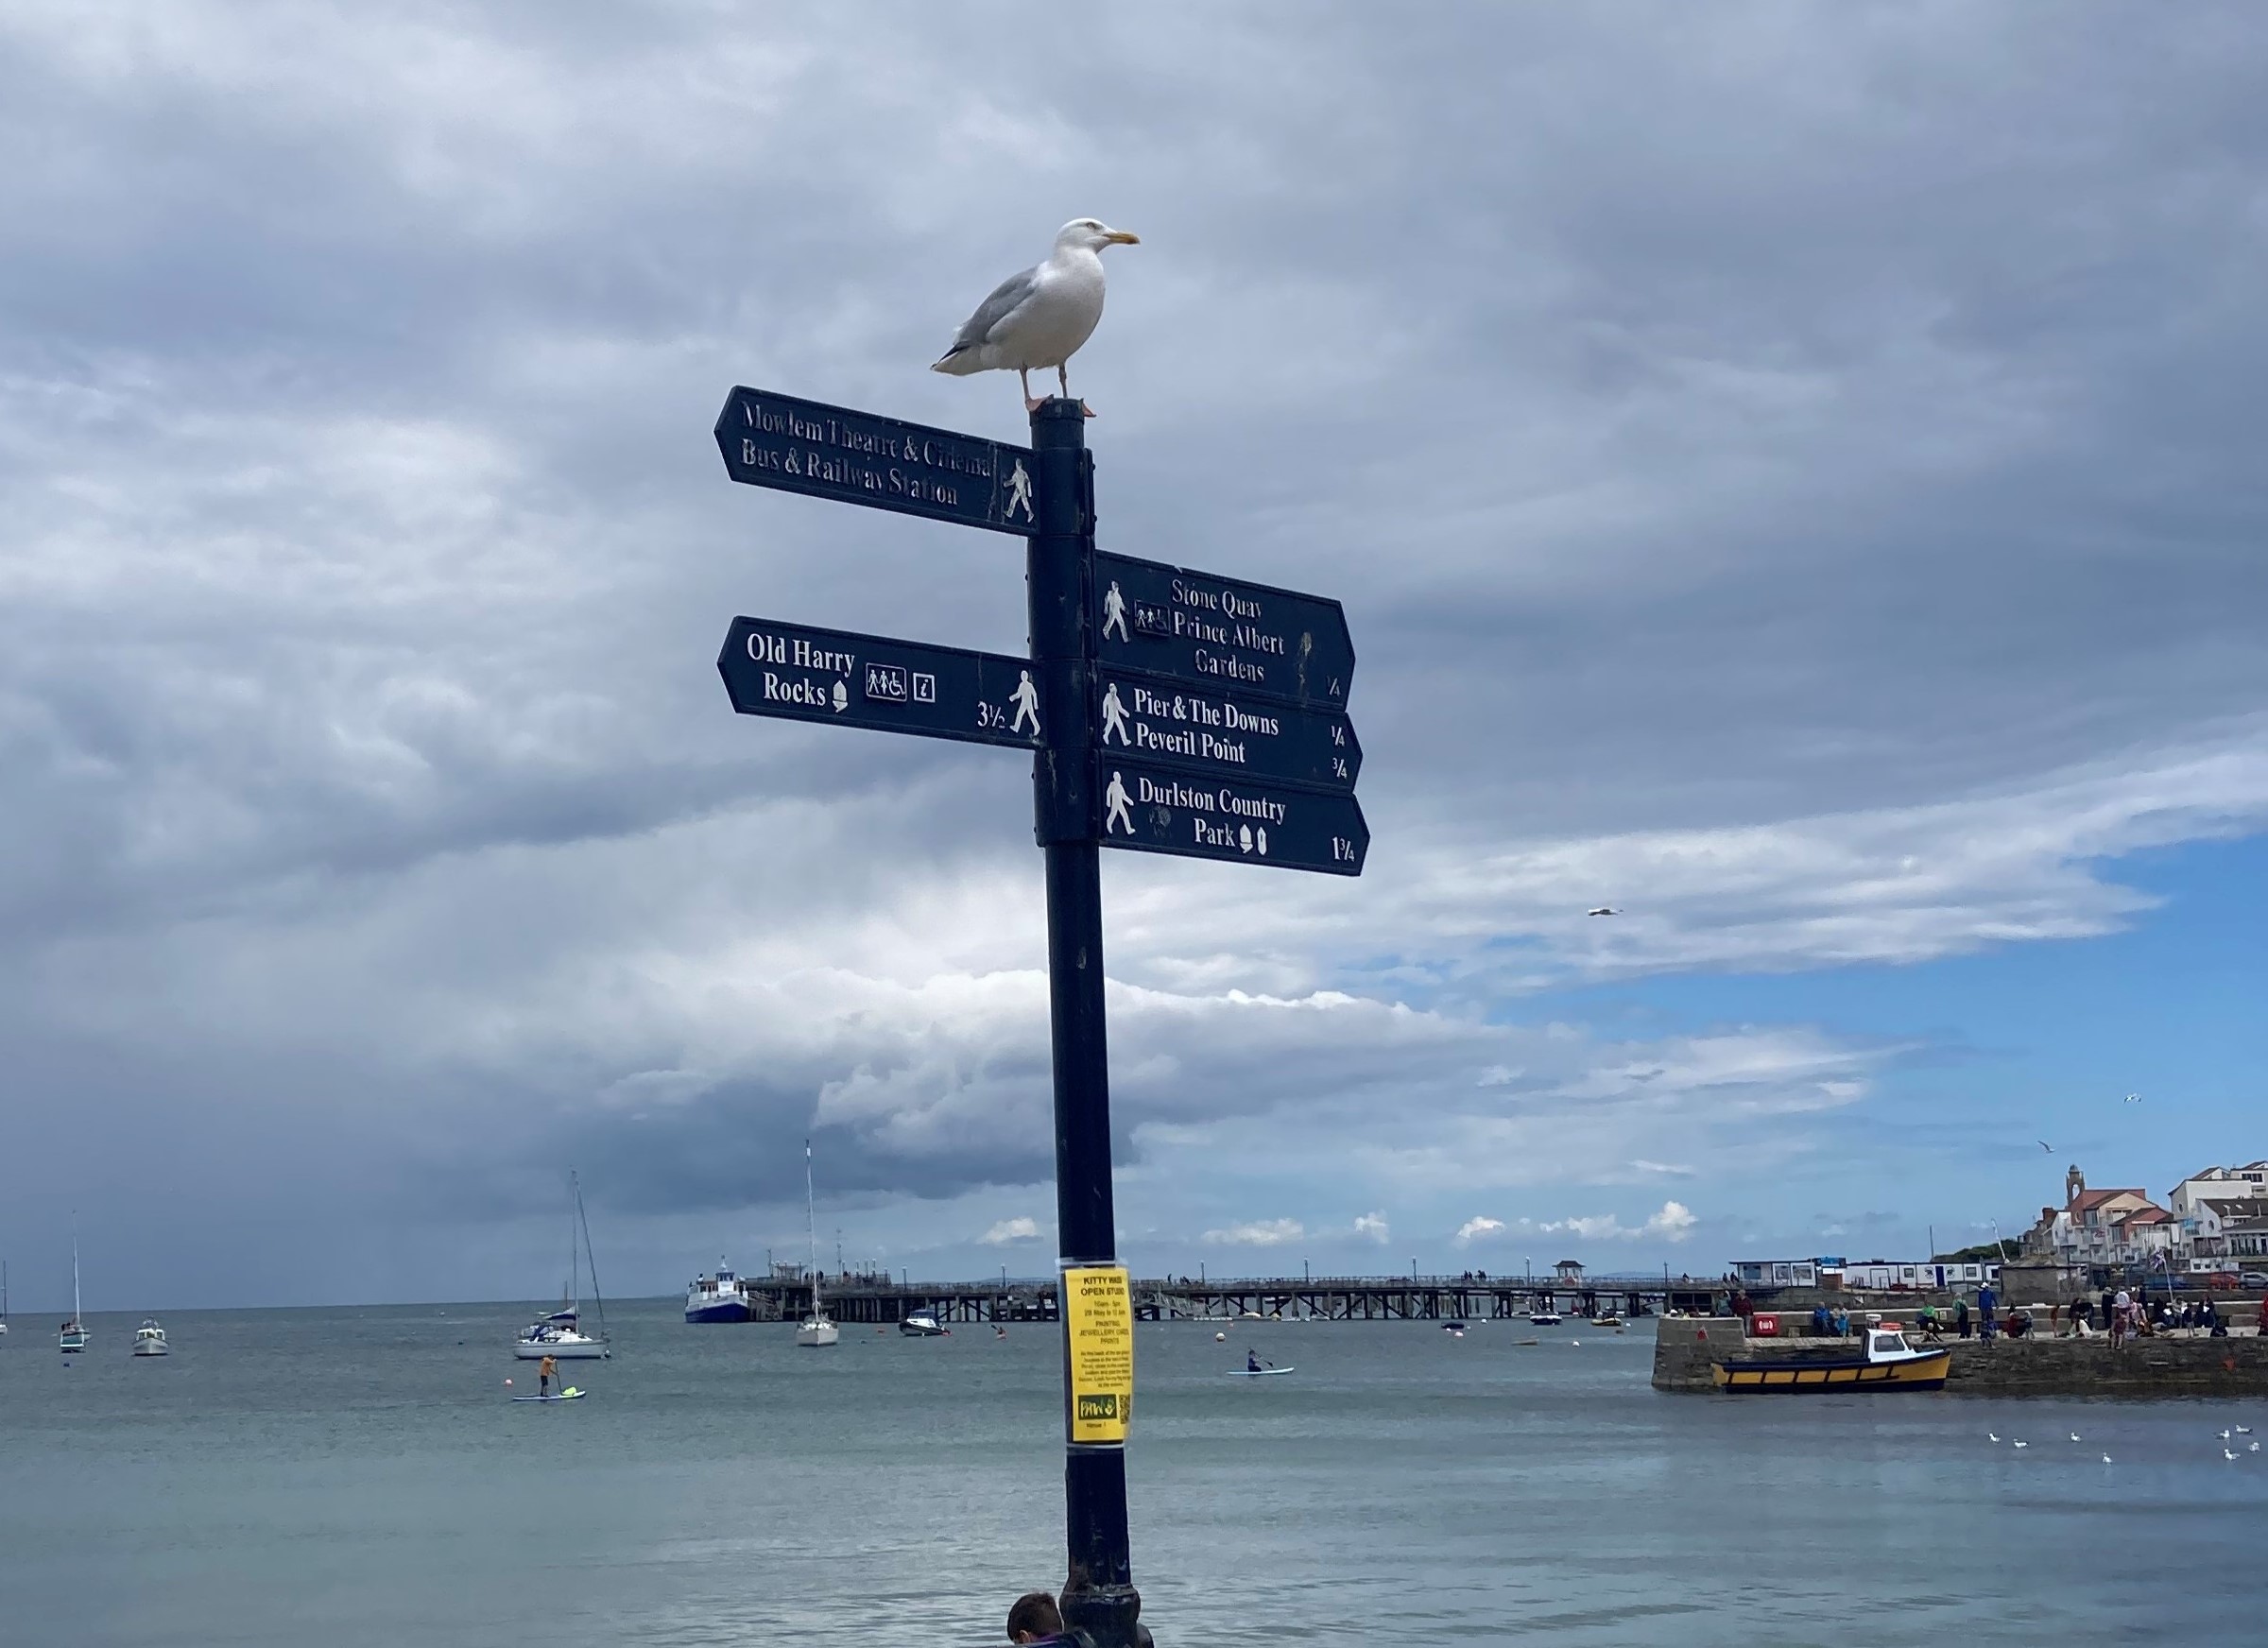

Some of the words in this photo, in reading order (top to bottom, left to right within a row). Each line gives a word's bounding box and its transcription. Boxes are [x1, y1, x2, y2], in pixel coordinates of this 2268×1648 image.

[741, 401, 822, 441] Mowlem
[828, 419, 898, 458] Theatre
[903, 436, 919, 462] &
[924, 440, 991, 477] Cinema
[741, 438, 779, 471] Bus
[785, 447, 800, 473] &
[807, 453, 883, 491] Railway
[889, 469, 958, 506] Station
[1172, 579, 1217, 609] Stone
[1222, 591, 1262, 619] Quay
[1175, 611, 1228, 644] Prince
[1232, 624, 1284, 655] Albert
[747, 633, 785, 663] Old
[793, 640, 854, 678] Harry
[1195, 648, 1264, 682] Gardens
[764, 672, 825, 706] Rocks
[1134, 688, 1170, 717] Pier
[1173, 695, 1186, 720] &
[1189, 698, 1221, 726] The
[1224, 703, 1279, 736] Downs
[1136, 723, 1194, 755] Peveril
[1201, 733, 1246, 764] Point
[1139, 778, 1214, 812] Durlston
[1219, 789, 1285, 825] Country
[1194, 818, 1235, 848] Park
[1083, 1276, 1107, 1284] KITTY
